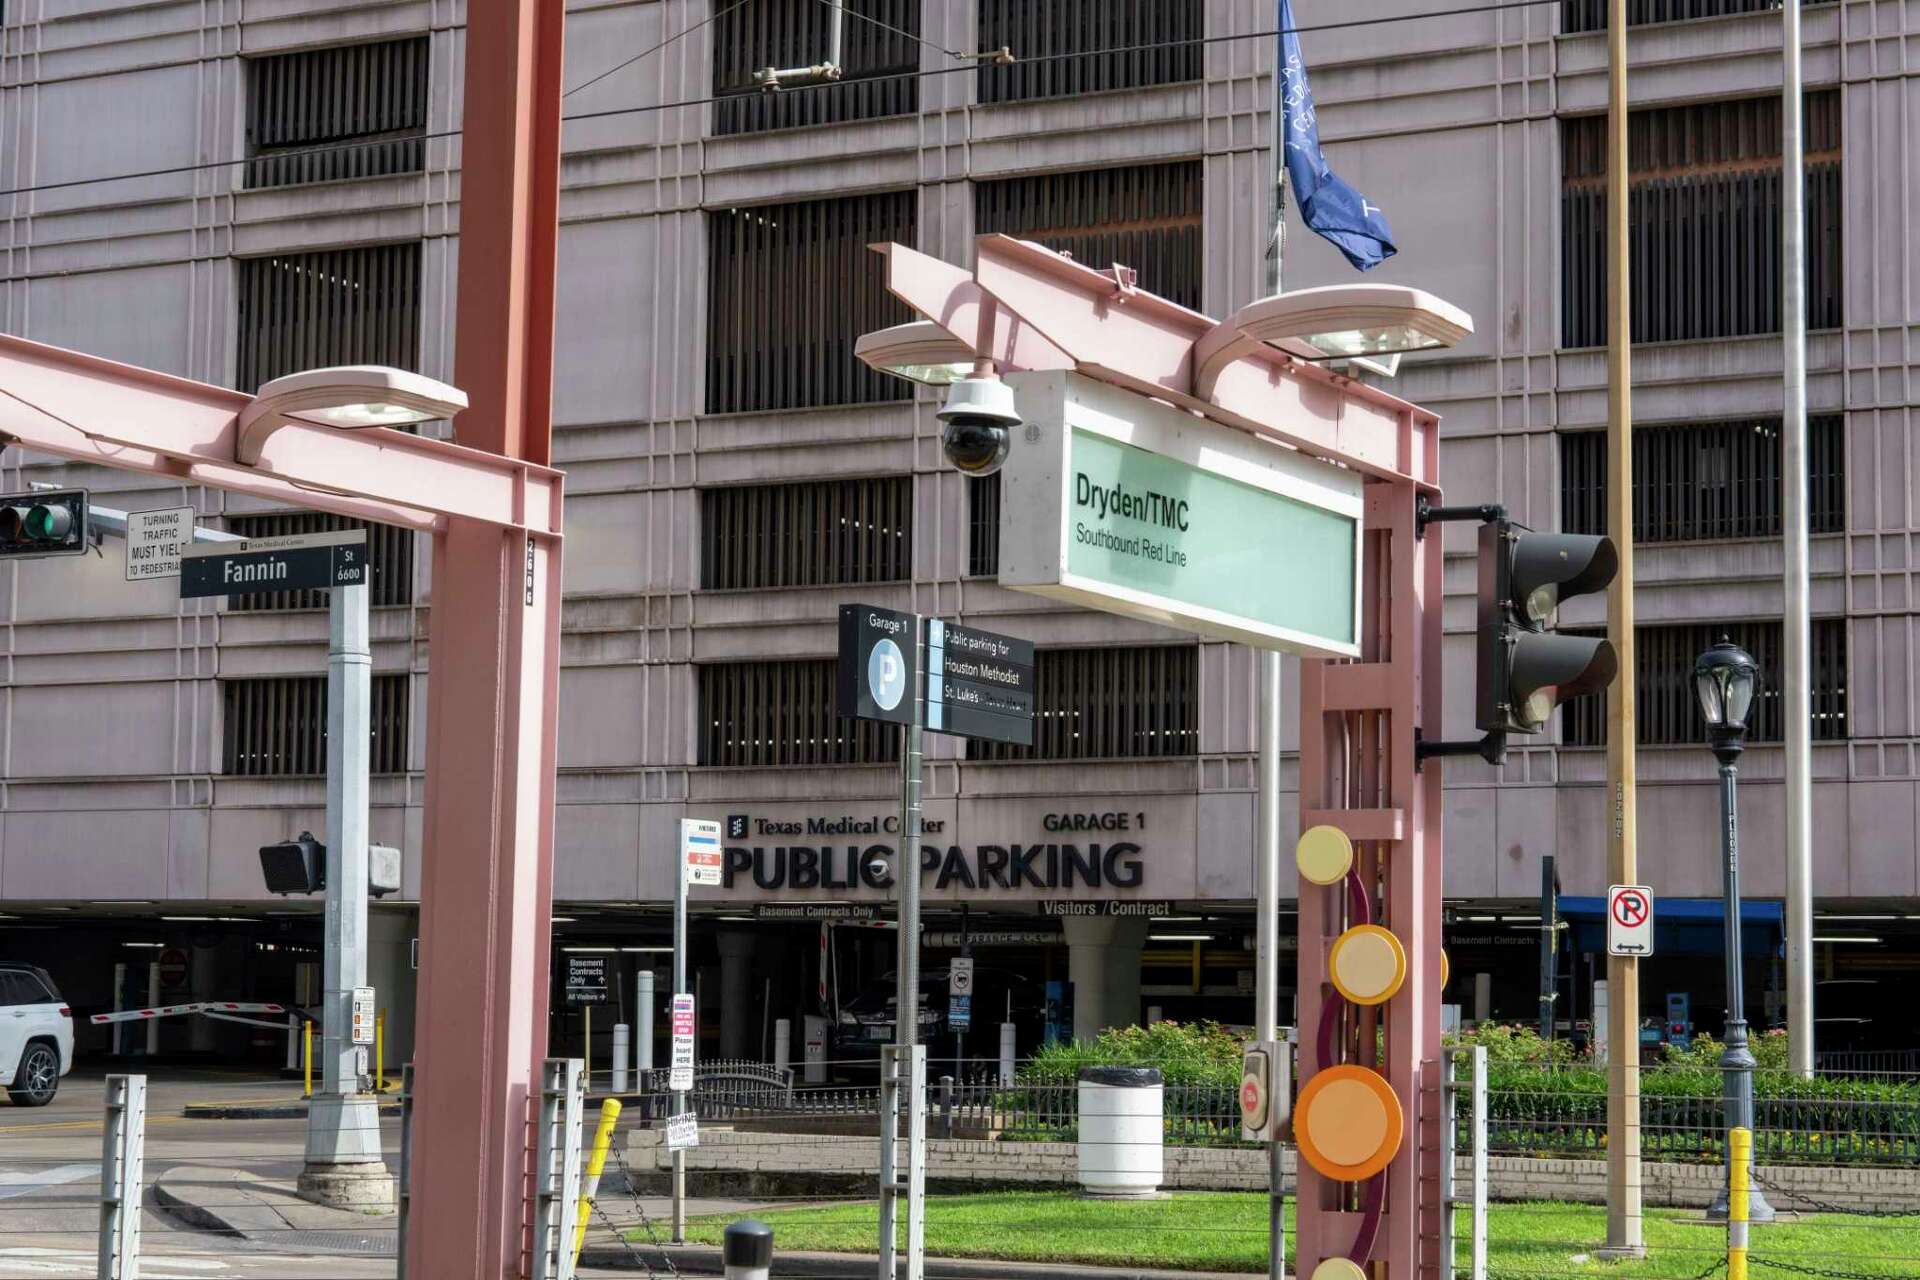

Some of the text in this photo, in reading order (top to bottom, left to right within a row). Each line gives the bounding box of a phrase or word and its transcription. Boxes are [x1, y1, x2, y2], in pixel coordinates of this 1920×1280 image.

[1077, 472, 1189, 532] Dryden/TMC
[143, 513, 180, 527] TURNING
[143, 528, 178, 541] TRAFFIC
[132, 542, 187, 560] MUST YIEL
[1076, 522, 1187, 567] Southbound Red Line
[344, 550, 354, 563] St
[129, 565, 138, 576] TO
[224, 556, 288, 583] Fannin
[337, 568, 361, 581] 6600
[869, 613, 908, 634] Garage 1
[944, 629, 1010, 657] Public parking for
[944, 656, 1020, 686] Houston Methodist
[945, 684, 955, 698] St.
[957, 687, 979, 703] Luke's
[754, 815, 945, 836] Texas Medical Cter
[1043, 812, 1145, 832] GARAGE 1
[723, 842, 1144, 891] PUBLIC PARKING
[759, 906, 874, 918] Basement Contracts Only
[1043, 900, 1097, 915] Visitors
[1451, 935, 1535, 945] Basement Contracts
[570, 959, 604, 967] Basement
[570, 968, 604, 976] Contracts
[570, 976, 586, 985] Only
[577, 993, 598, 1001] Visitors
[675, 1036, 692, 1044] Please
[677, 1056, 691, 1064] HERE
